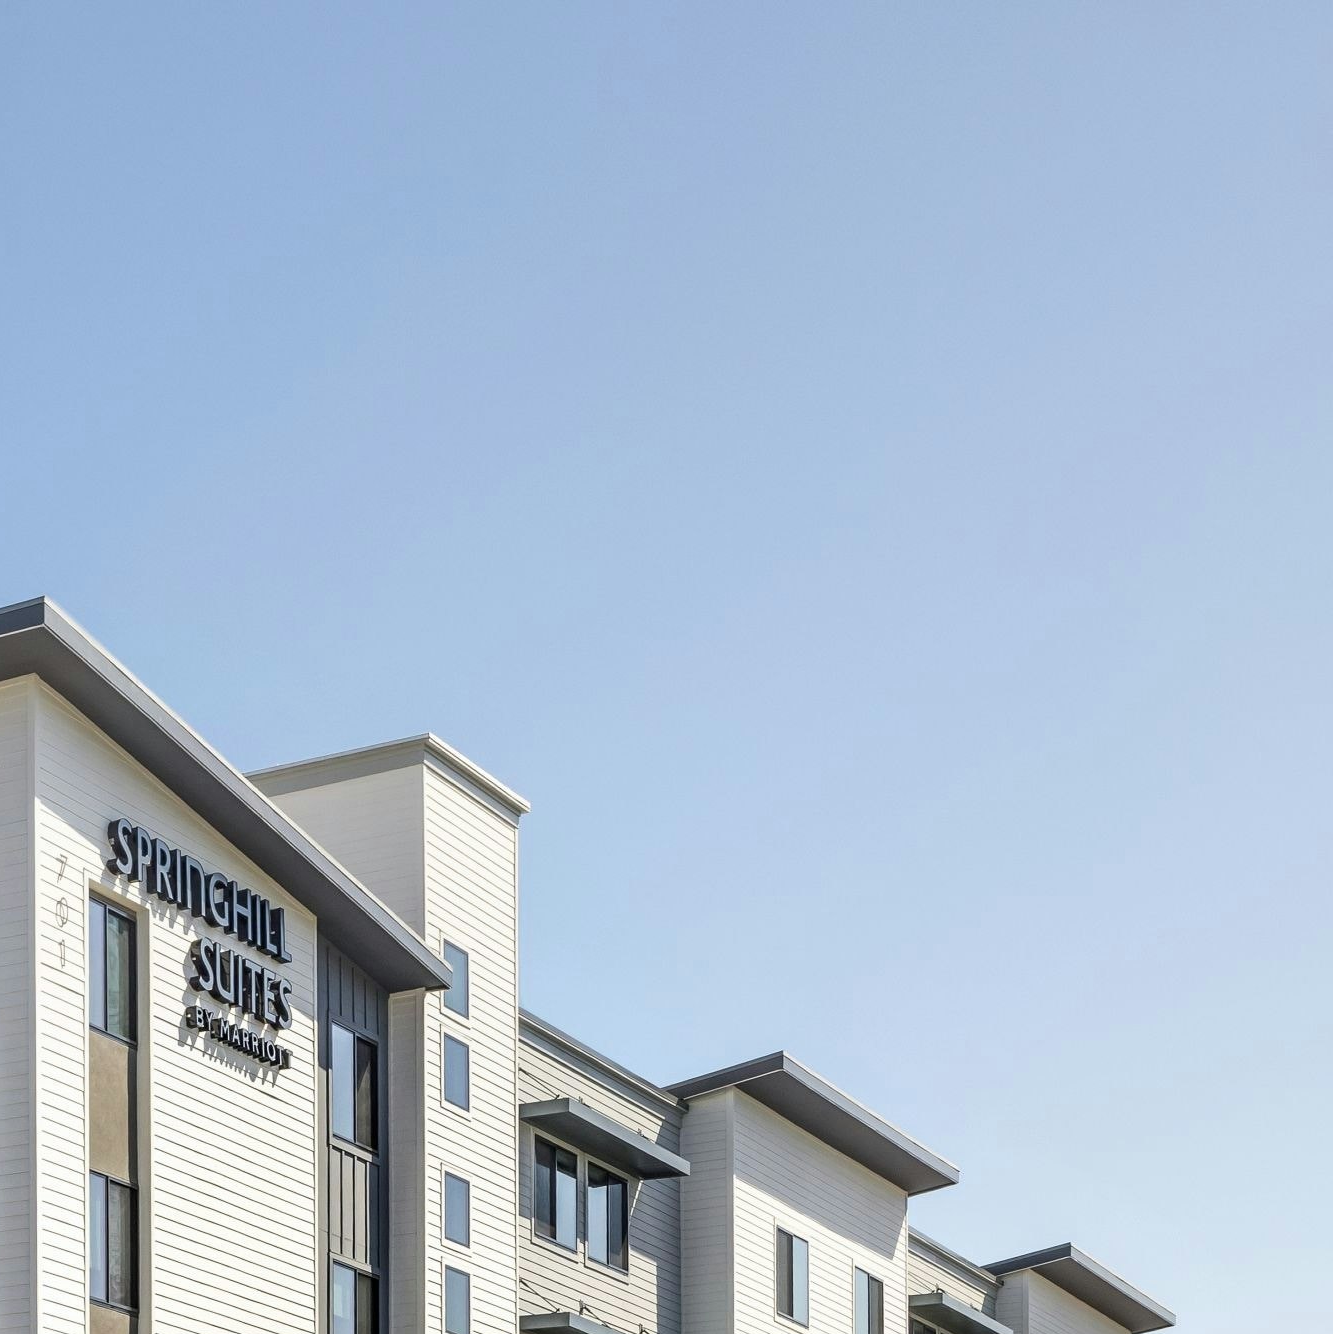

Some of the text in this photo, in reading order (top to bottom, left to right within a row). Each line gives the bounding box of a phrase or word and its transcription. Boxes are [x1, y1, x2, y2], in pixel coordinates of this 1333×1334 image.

[107, 818, 293, 964] SPRINGHILL
[186, 1005, 215, 1032] BY
[190, 937, 293, 1030] SUITES
